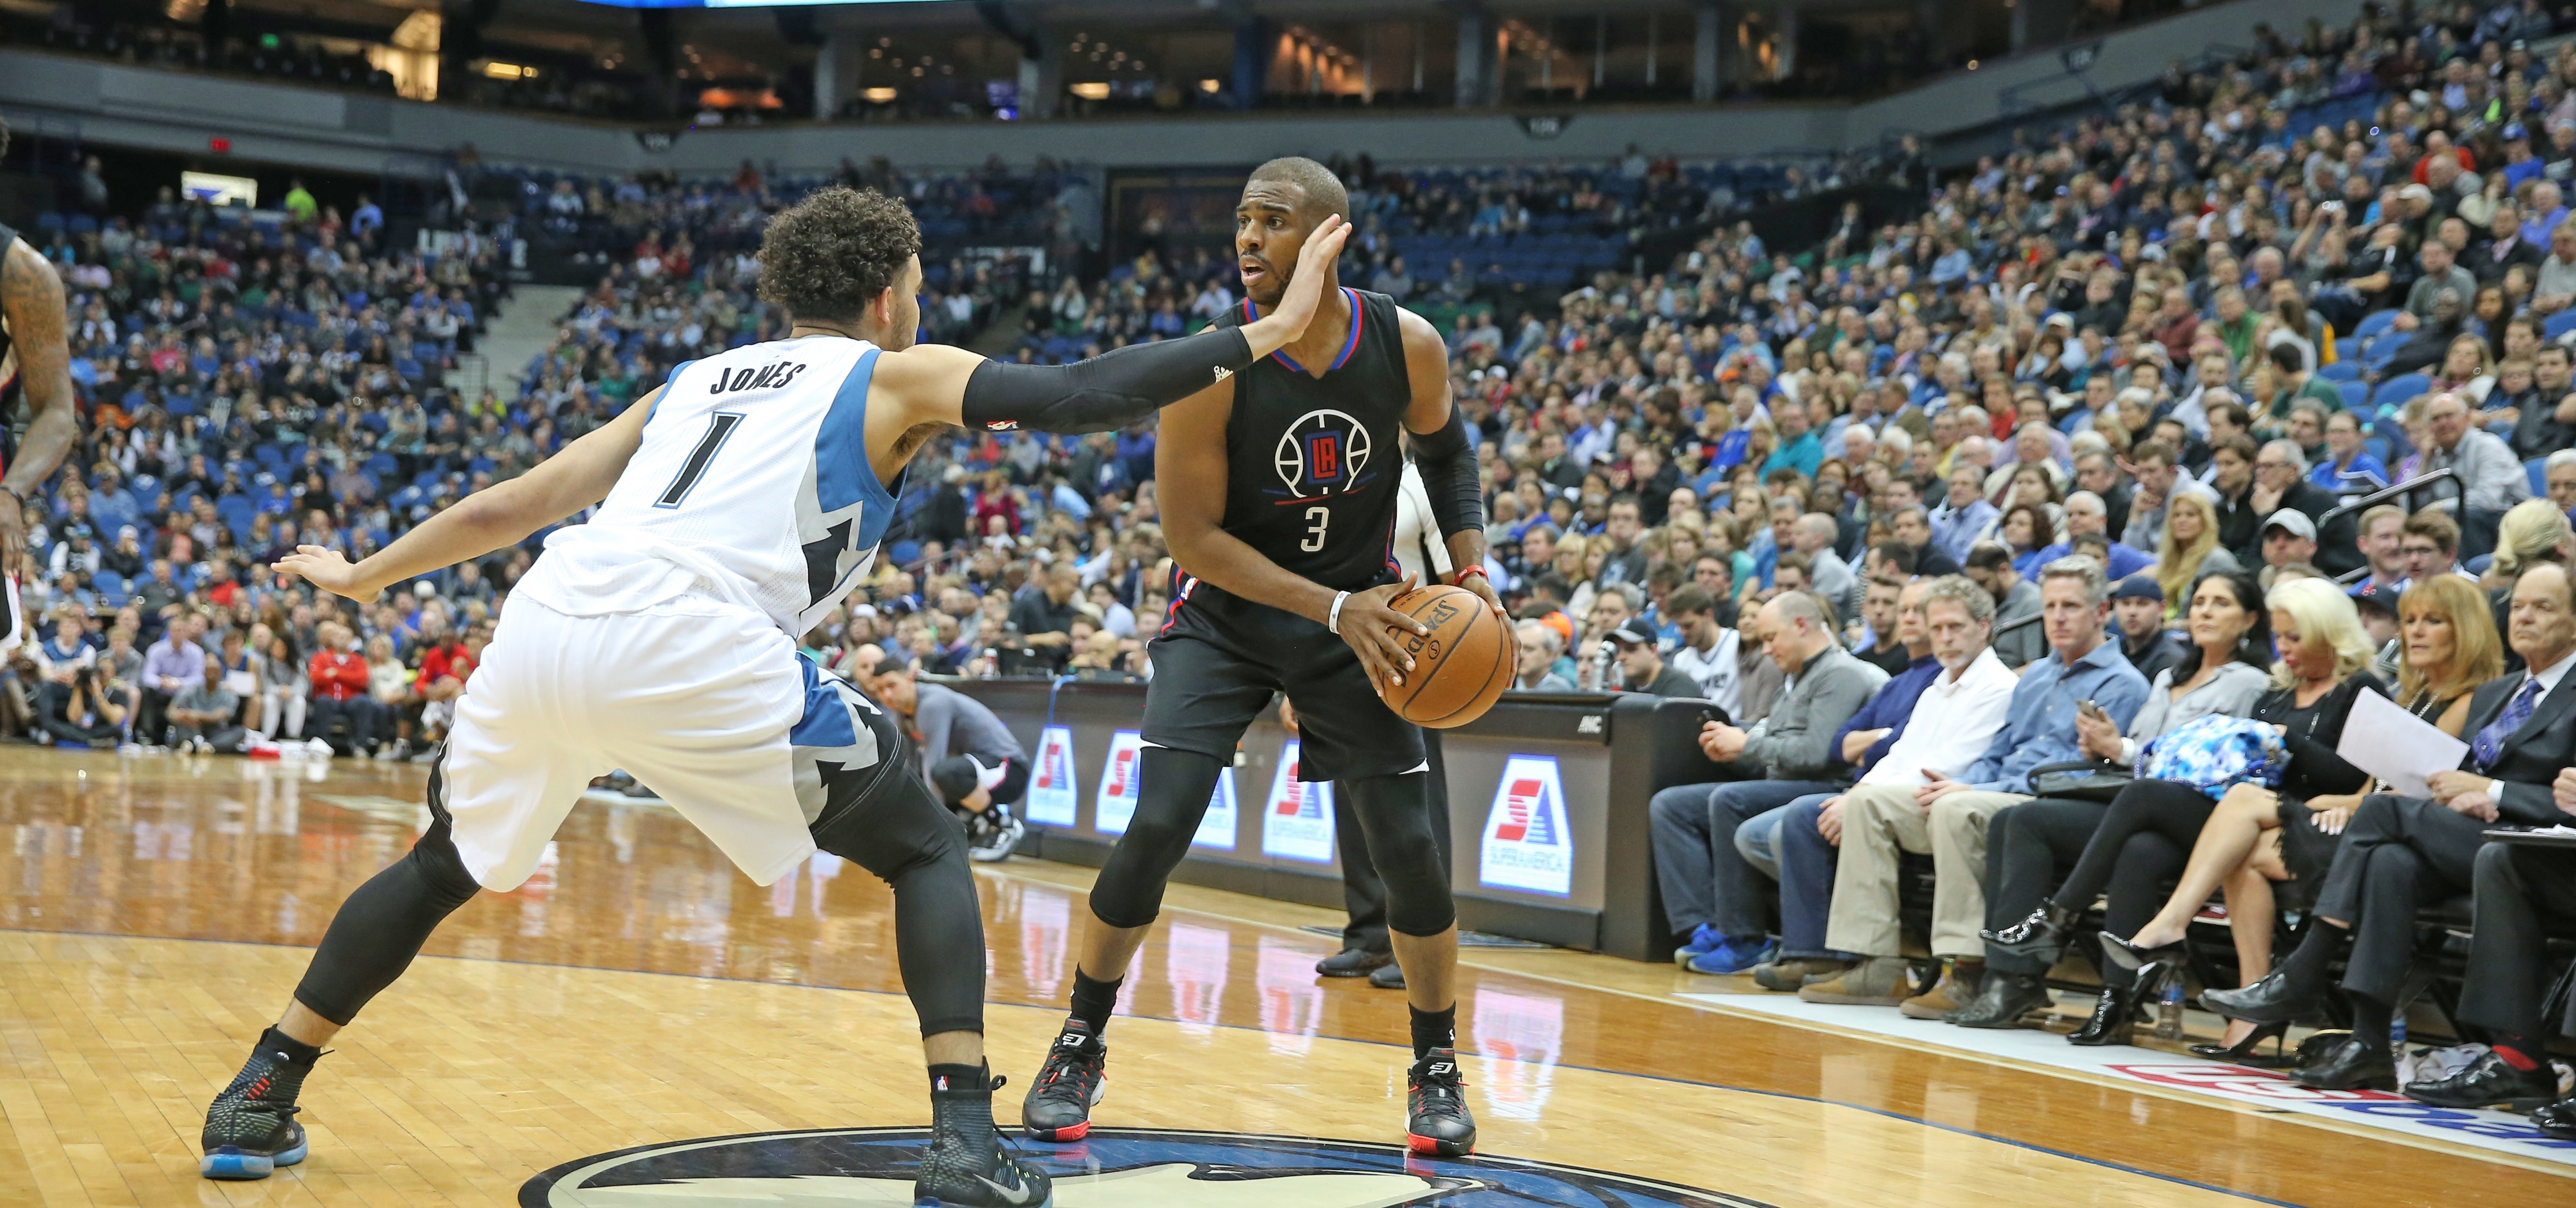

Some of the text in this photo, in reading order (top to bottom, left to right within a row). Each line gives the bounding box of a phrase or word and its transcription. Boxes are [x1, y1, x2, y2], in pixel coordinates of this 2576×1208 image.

[710, 361, 806, 394] JONES
[652, 411, 747, 510] 1
[1300, 507, 1330, 552] 3
[1394, 599, 1459, 687] SPADN
